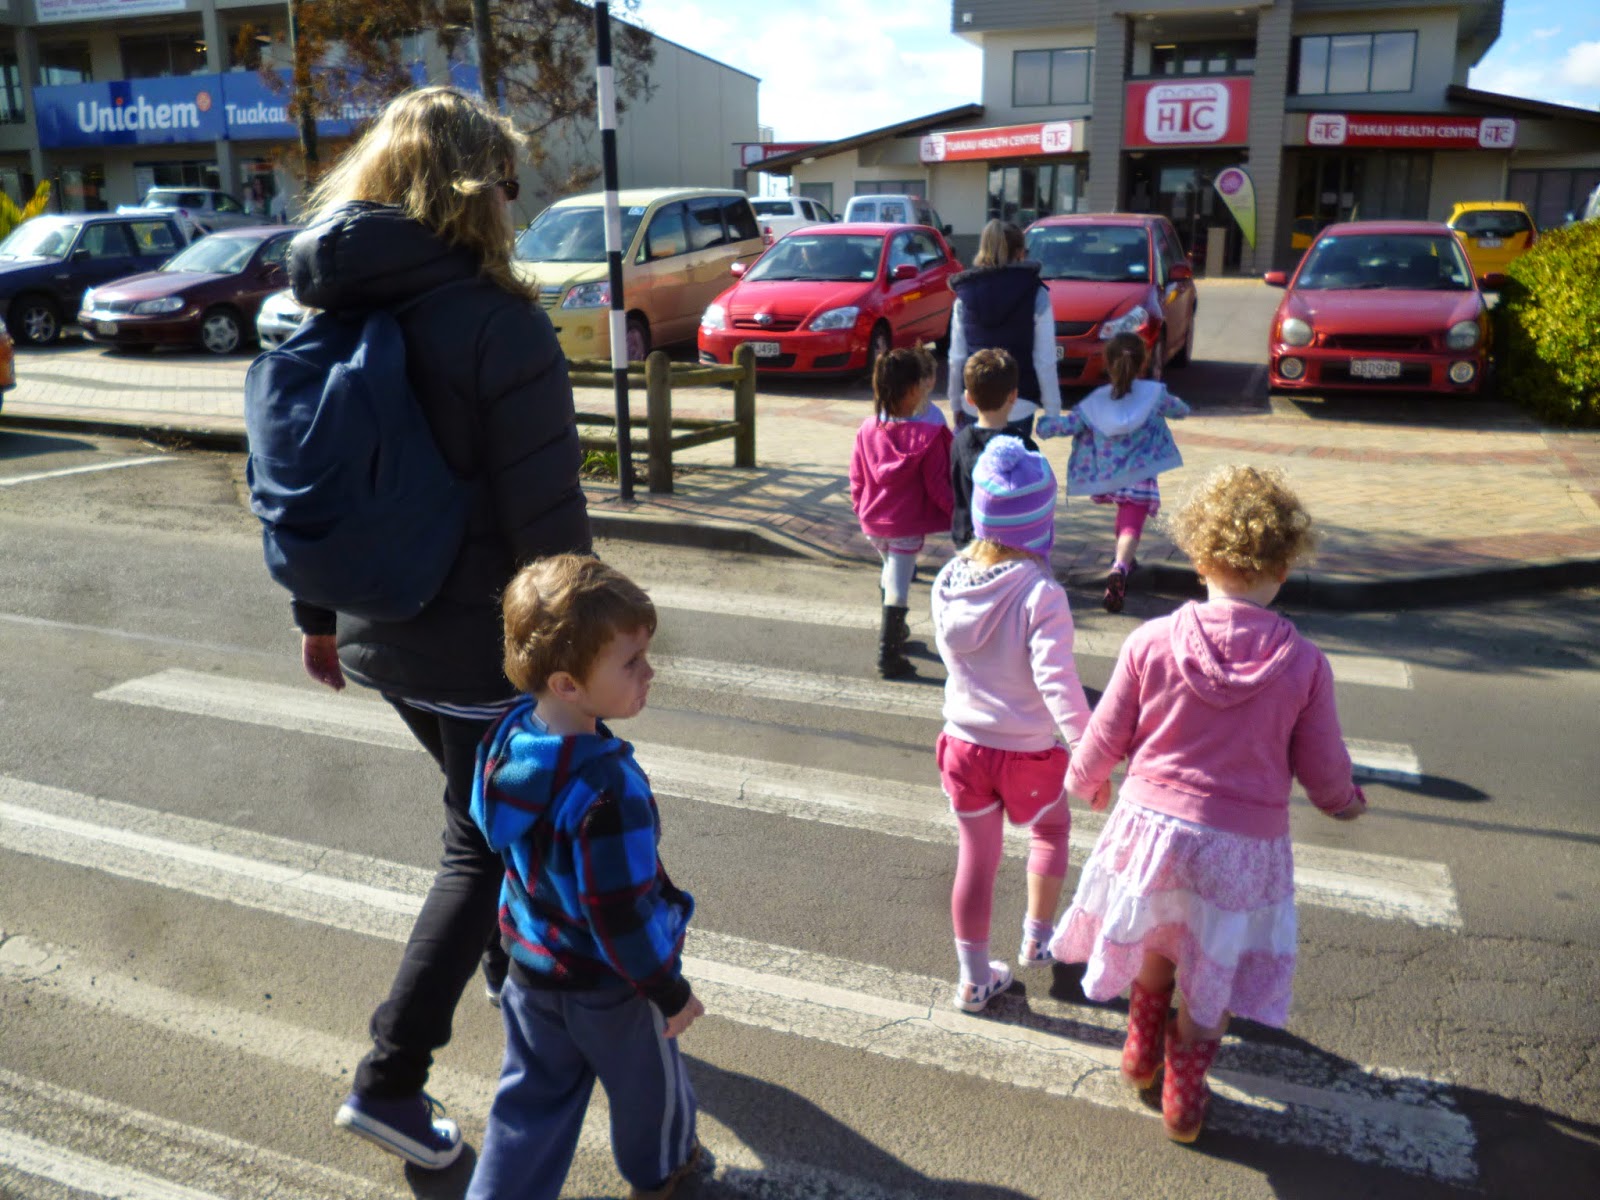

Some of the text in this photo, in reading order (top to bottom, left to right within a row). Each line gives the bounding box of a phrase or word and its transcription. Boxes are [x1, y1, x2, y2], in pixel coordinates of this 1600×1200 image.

[78, 95, 200, 133] Unichem
[1157, 97, 1217, 132] HTC
[946, 140, 977, 152] TUAKAU
[977, 136, 1008, 149] HEALTH
[1009, 133, 1041, 147] CENTRE
[1313, 122, 1510, 142] HTC TUAKAU HEALTH CENTRE HTC
